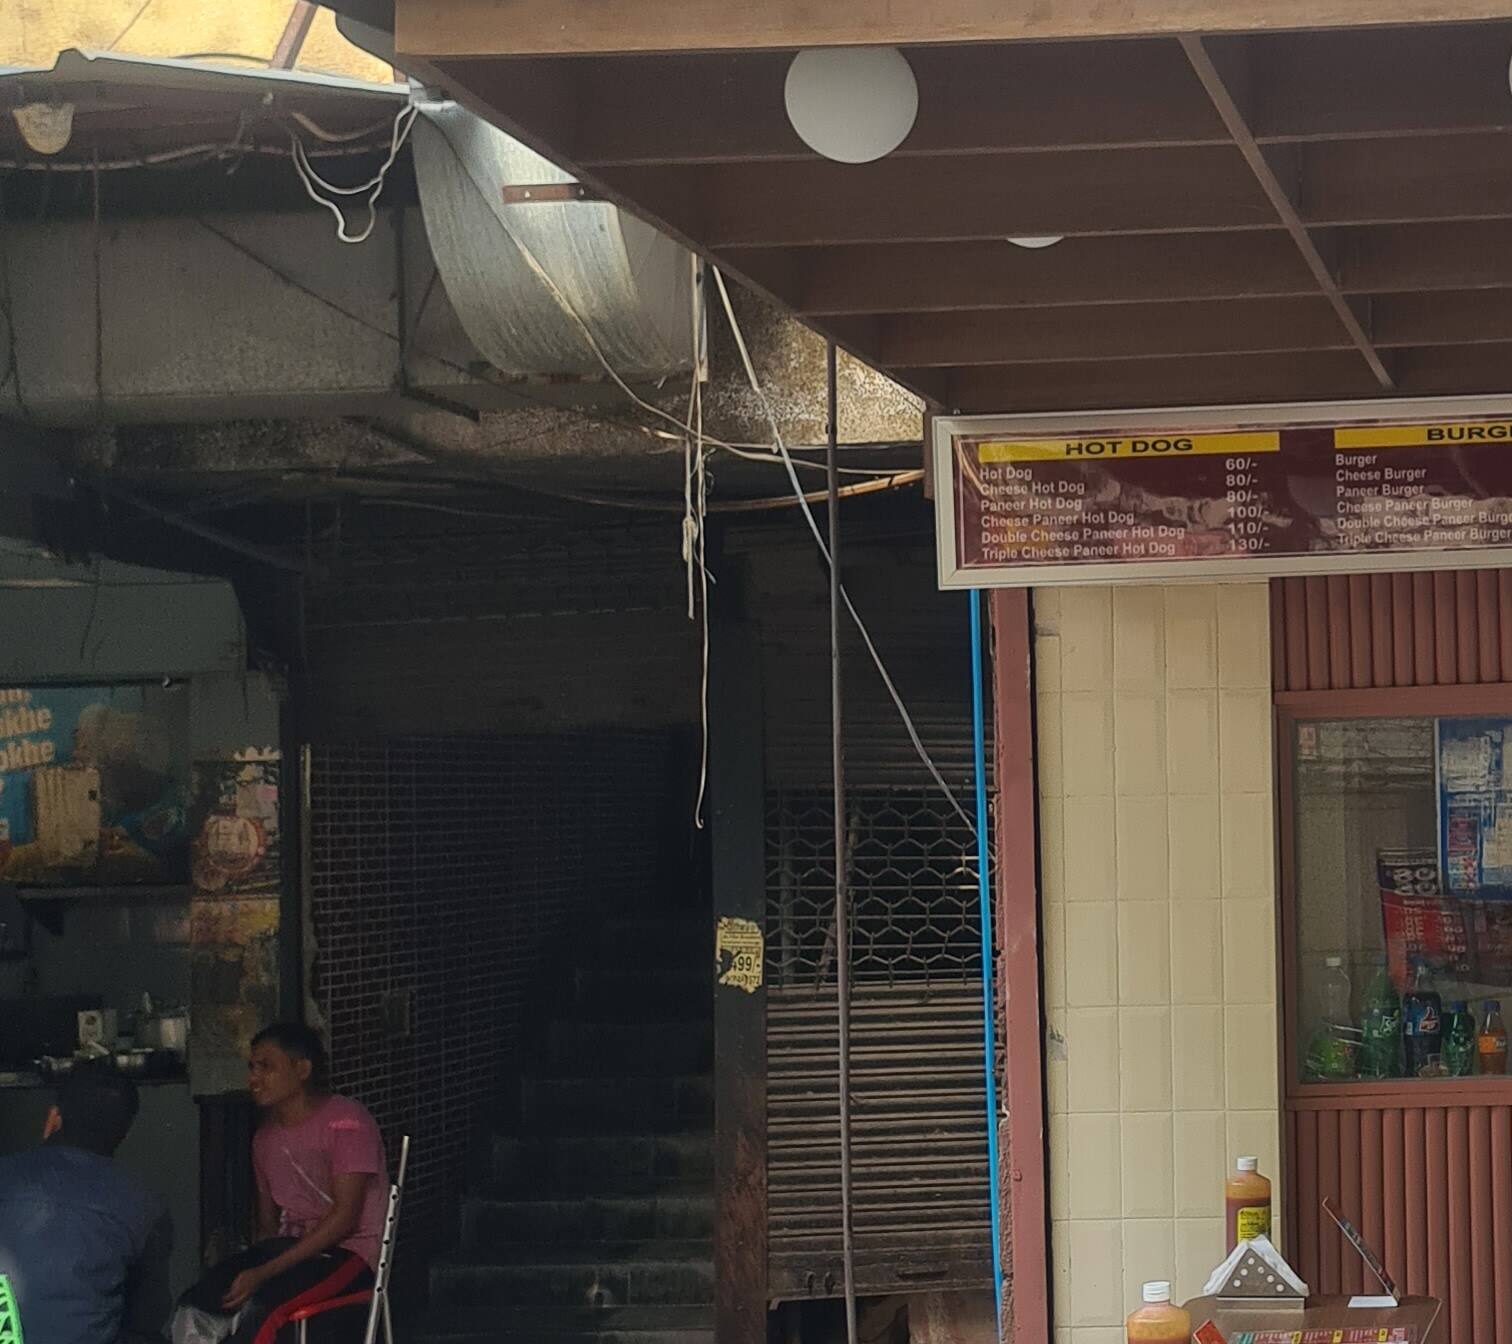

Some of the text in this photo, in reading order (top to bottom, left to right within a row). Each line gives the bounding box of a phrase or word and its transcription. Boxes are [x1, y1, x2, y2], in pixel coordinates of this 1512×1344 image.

[1065, 438, 1193, 455] HOT DOG
[980, 457, 1257, 481] Hot Dog 60/-
[1335, 453, 1377, 468] Burger
[1335, 469, 1381, 482] Cheese
[1384, 467, 1427, 481] Burger
[1032, 482, 1055, 494] Hot
[1058, 481, 1085, 495] Dog
[1226, 473, 1258, 487] 80/-
[1382, 483, 1425, 498] Burger
[1029, 498, 1052, 510] Hot
[1056, 497, 1082, 512] Dog
[1226, 489, 1258, 503] 80/-
[1431, 498, 1474, 512] Burger
[981, 515, 1029, 528] Cheese
[1082, 512, 1105, 524] Hot
[1108, 511, 1134, 525] Dog
[1227, 505, 1269, 518] 100/-
[1337, 517, 1380, 529] Double
[981, 531, 1027, 544] Double
[1031, 529, 1079, 542] Cheese
[1132, 527, 1154, 538] Hot
[1158, 525, 1185, 539] Dog
[1228, 521, 1269, 534] 110/-
[1470, 527, 1512, 541] Burger
[982, 537, 1271, 561] Triple Cheese Paneer Hot Dog 130/-
